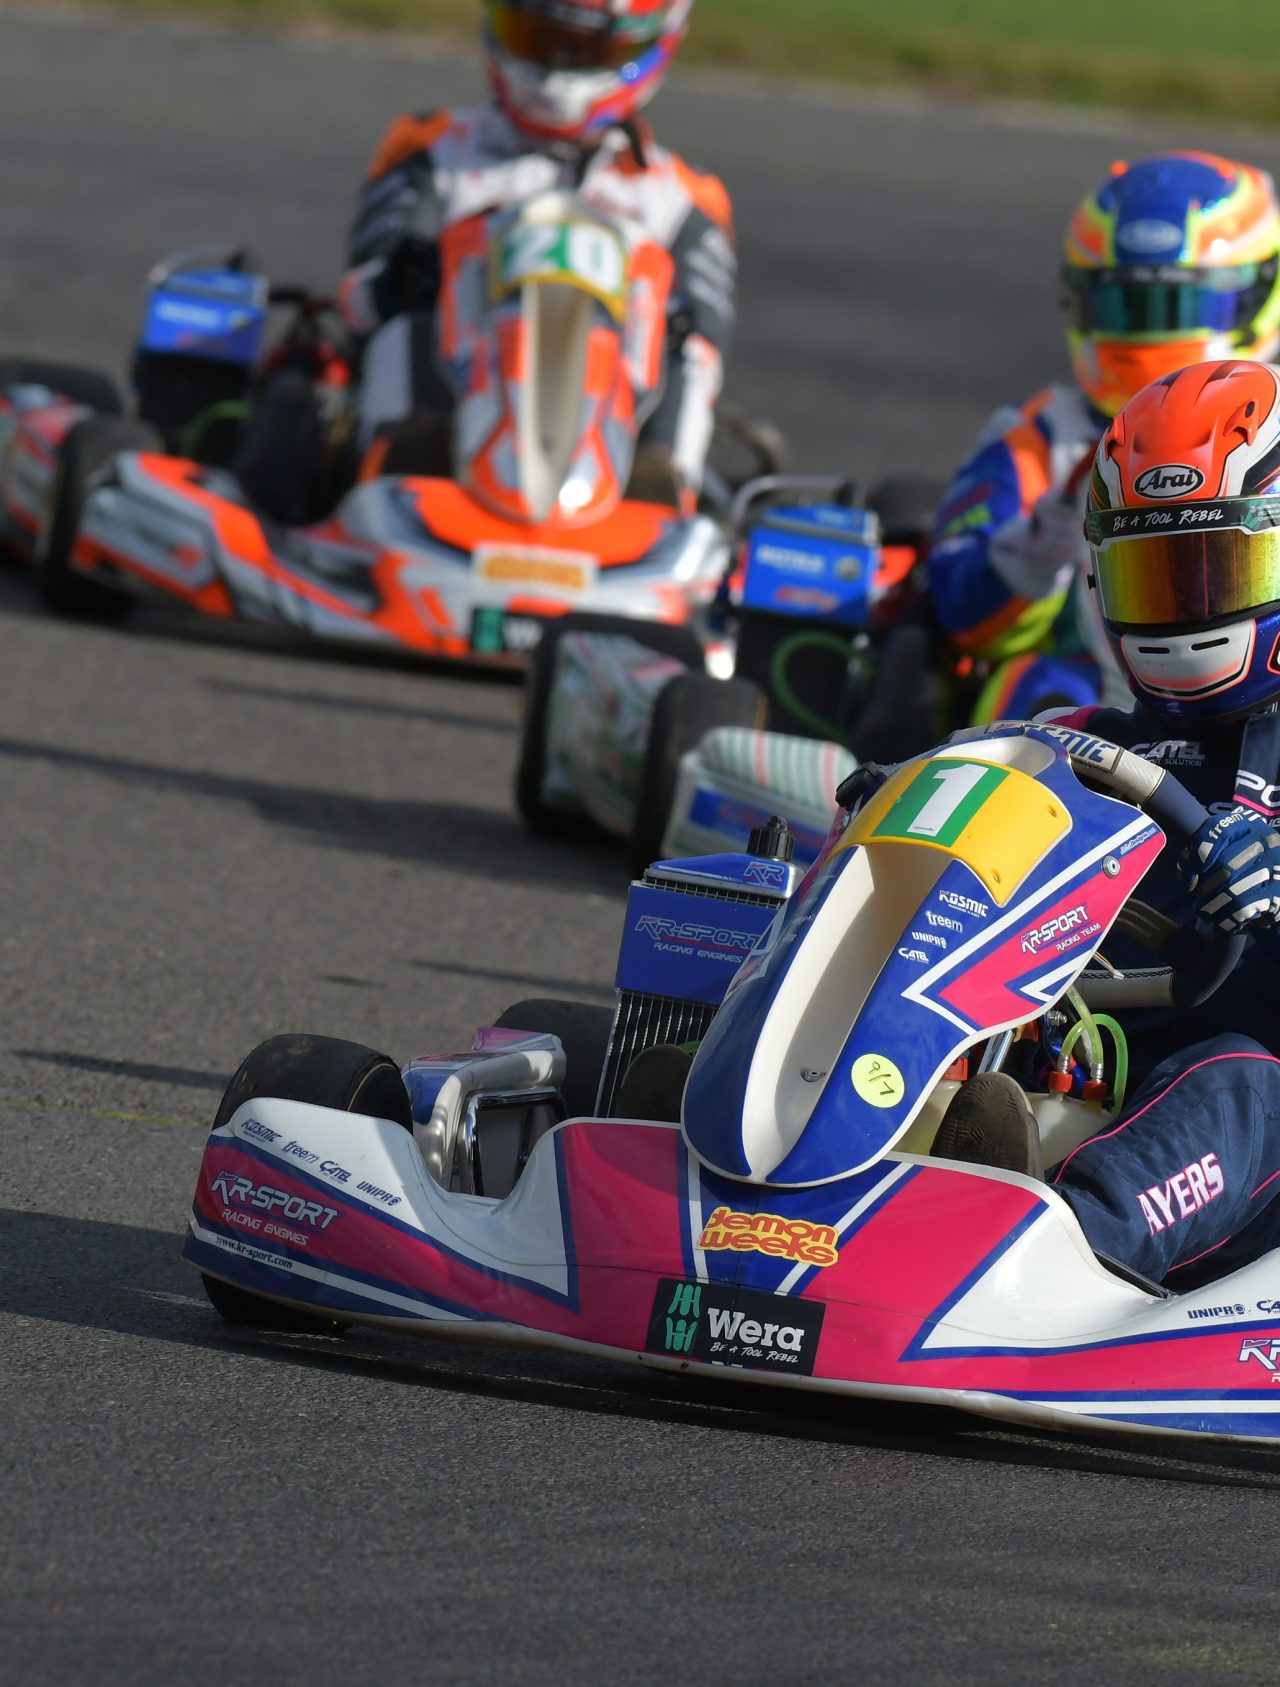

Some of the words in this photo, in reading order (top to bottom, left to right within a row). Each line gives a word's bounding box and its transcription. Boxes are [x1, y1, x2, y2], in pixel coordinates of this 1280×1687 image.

[503, 223, 625, 293] 20
[1139, 469, 1195, 494] Arai
[1113, 516, 1126, 532] BE
[1130, 515, 1139, 527] A
[1145, 511, 1173, 527] TOOL
[1178, 508, 1224, 526] REBEL
[1164, 759, 1202, 767] SOLUTION
[907, 763, 989, 837] 1
[1208, 812, 1244, 841] freem
[744, 862, 784, 886] KR
[939, 889, 989, 918] KOSMIC
[635, 915, 761, 950] KR-SPORT
[925, 910, 963, 933] freem
[1020, 904, 1090, 954] KR-SPORT
[1055, 933, 1081, 951] RACING
[1081, 922, 1102, 938] TEAM
[653, 941, 695, 955] RACING
[697, 949, 744, 964] ENGINES
[241, 1118, 283, 1143] KOSMIC
[281, 1140, 320, 1164] freem
[319, 1160, 353, 1183] CATEL
[211, 1171, 338, 1230] KR-SPORT
[355, 1180, 402, 1206] UNIPRO
[1136, 1152, 1224, 1237] AYERS
[222, 1208, 261, 1230] RACING
[264, 1223, 309, 1246] ENGINES
[215, 1236, 293, 1270] www.kr-sport.com
[698, 1230, 835, 1264] weeks
[1187, 1303, 1246, 1319] UNIPRO
[707, 1307, 805, 1352] Wera
[710, 1341, 727, 1353] BE
[729, 1345, 739, 1354] A
[741, 1346, 763, 1357] TOOL
[766, 1350, 799, 1364] REBEL
